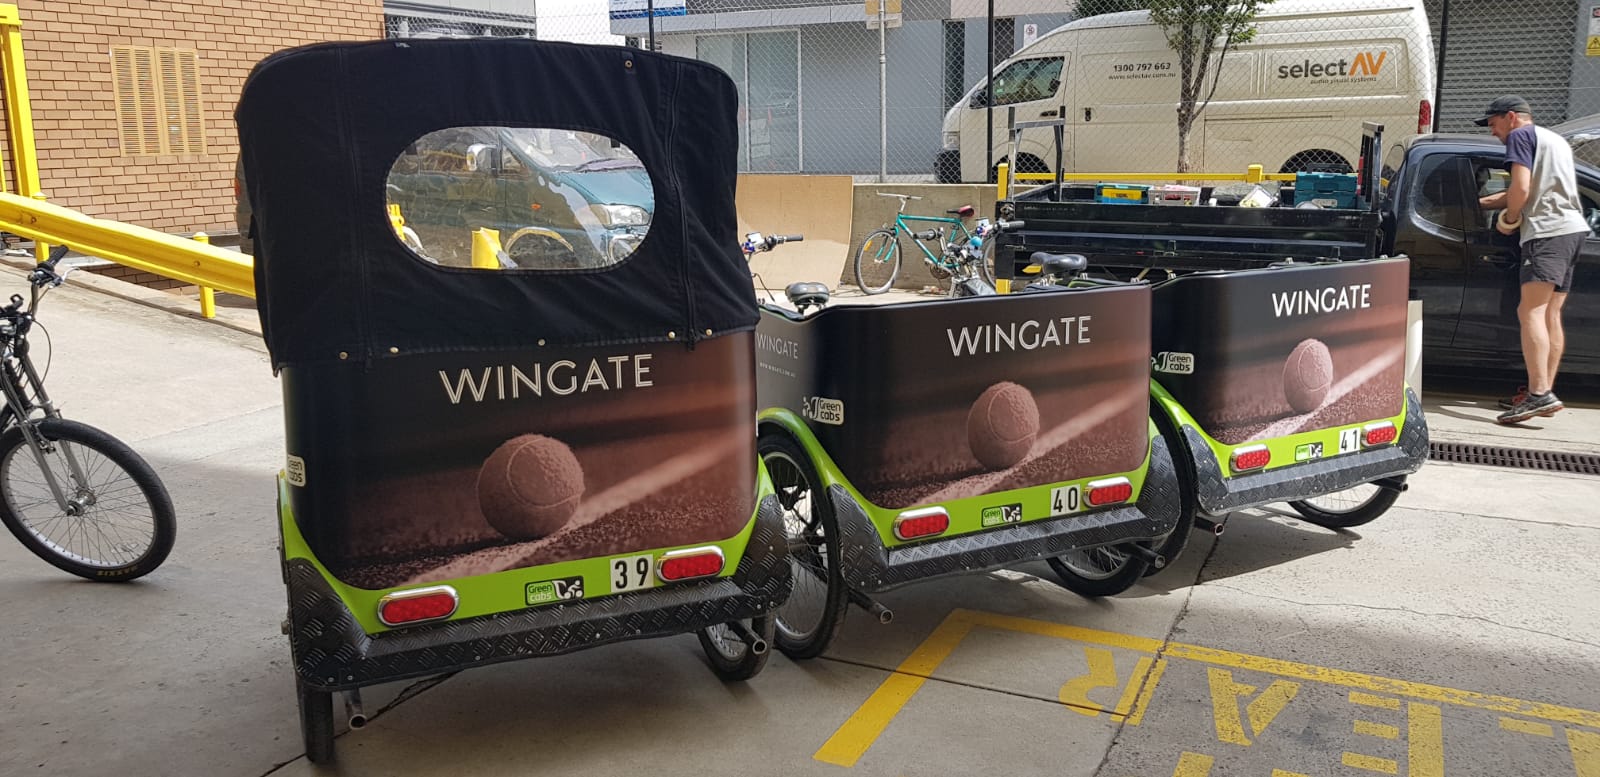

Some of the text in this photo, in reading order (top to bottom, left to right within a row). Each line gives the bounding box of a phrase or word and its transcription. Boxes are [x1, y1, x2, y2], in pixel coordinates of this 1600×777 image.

[1113, 63, 1134, 73] 1300
[1136, 62, 1153, 72] 797
[1271, 283, 1372, 318] WINGATE
[947, 315, 1092, 357] WINGATE
[756, 332, 799, 359] WINGATE
[1169, 353, 1192, 363] Green
[1169, 362, 1191, 372] cabs
[438, 353, 653, 404] WINGATE
[819, 399, 841, 412] Green
[820, 409, 841, 422] cabs
[1340, 428, 1359, 452] 41
[1053, 487, 1079, 513] 40
[984, 508, 1001, 519] Green
[614, 557, 649, 590] 39
[528, 583, 553, 595] Green
[529, 592, 552, 603] cabs
